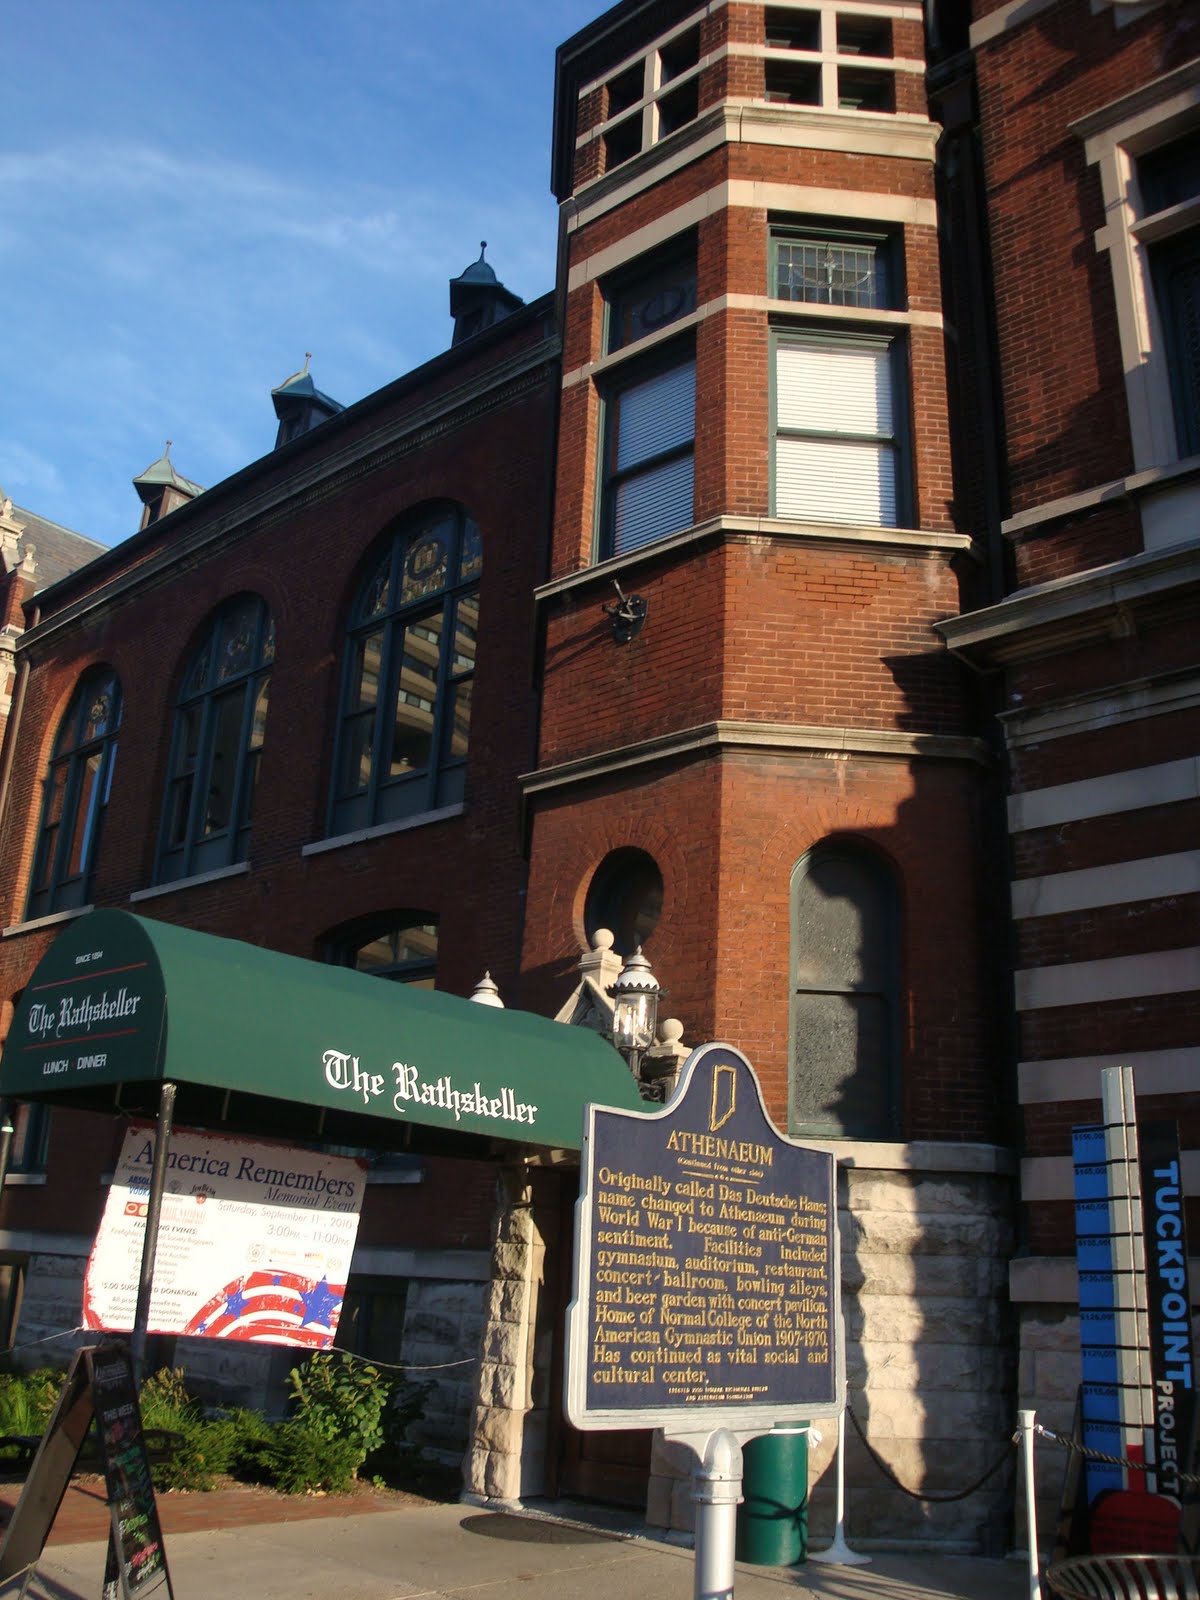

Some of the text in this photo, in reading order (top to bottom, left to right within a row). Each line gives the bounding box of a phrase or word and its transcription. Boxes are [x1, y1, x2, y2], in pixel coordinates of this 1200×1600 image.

[75, 953, 91, 965] SINCE
[29, 987, 141, 1039] The Rathskeller
[43, 1054, 107, 1075] LUNCH DINNER
[323, 1049, 539, 1125] The Rathskeller
[666, 1130, 773, 1168] ATHENAEUM
[235, 1157, 356, 1197] Remembers
[599, 1167, 672, 1196] Originally
[675, 1181, 715, 1199] called
[719, 1184, 743, 1203] Das
[746, 1189, 797, 1209] Deutsche
[217, 1200, 257, 1217] Saturday,
[260, 1207, 307, 1220] September
[330, 1217, 353, 1230] 2010
[264, 1187, 357, 1213] Memorial Event
[598, 1191, 827, 1233] name changed to Athenaeum during
[599, 1206, 827, 1246] World War I because of anti-German
[597, 1230, 827, 1262] sentiment. Facilities included
[597, 1250, 828, 1280] gymnasium, auditorium, restaurant,
[1154, 1161, 1192, 1389] TUCKPOINT
[160, 1287, 198, 1297] DONATION
[595, 1286, 828, 1315] and beer garden with concert pavilion.
[736, 1276, 785, 1297] bowling
[790, 1280, 828, 1298] alleys,
[595, 1305, 828, 1330] Home of Normal College of the North
[594, 1325, 661, 1344] American
[665, 1327, 733, 1348] Gymnastic
[737, 1329, 772, 1346] Union
[593, 1345, 829, 1364] Has continued as vital social and
[593, 1366, 655, 1384] cultural
[1156, 1381, 1180, 1494] PROJECT
